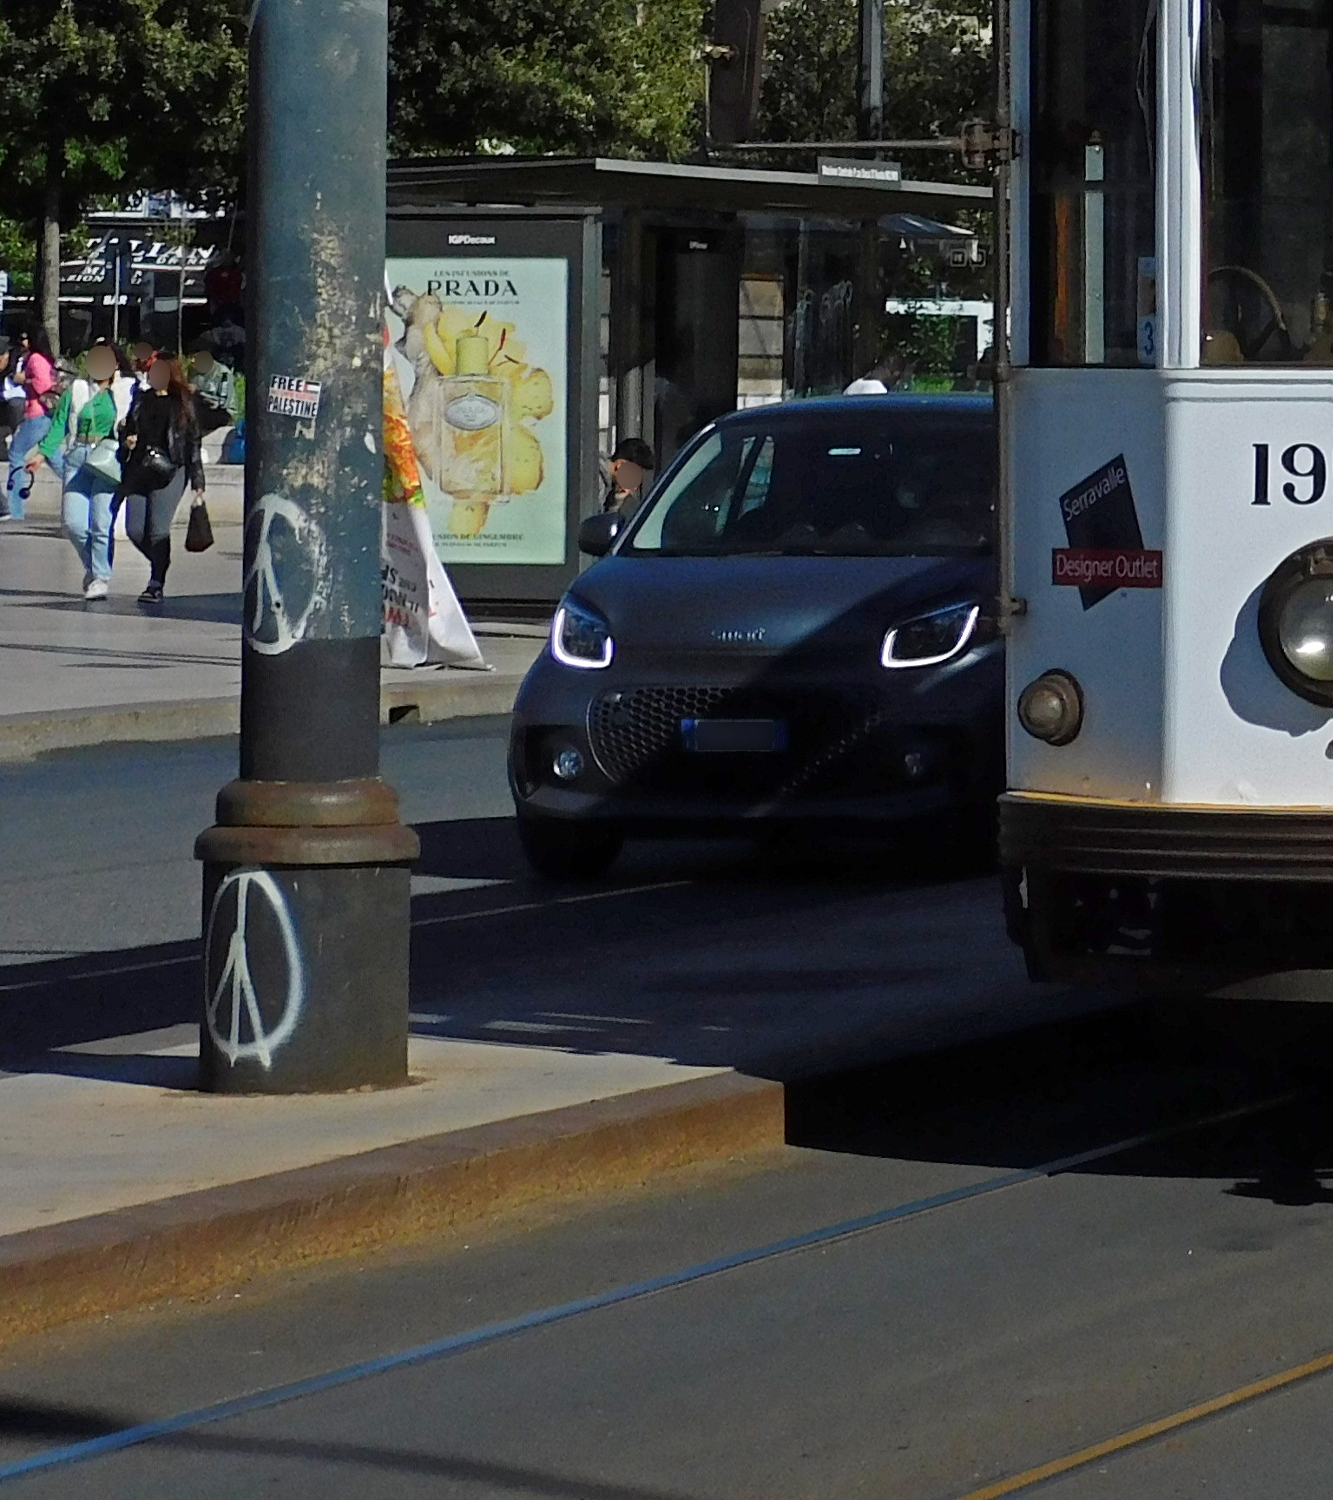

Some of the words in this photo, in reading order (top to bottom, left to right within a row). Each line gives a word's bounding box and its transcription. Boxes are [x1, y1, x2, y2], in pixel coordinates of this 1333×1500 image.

[427, 280, 518, 296] PRADA
[271, 376, 303, 393] FREE
[266, 396, 317, 417] PALESTINE
[1063, 466, 1125, 522] Serravalle
[1056, 554, 1114, 582] Designer
[1116, 555, 1158, 579] Outlet
